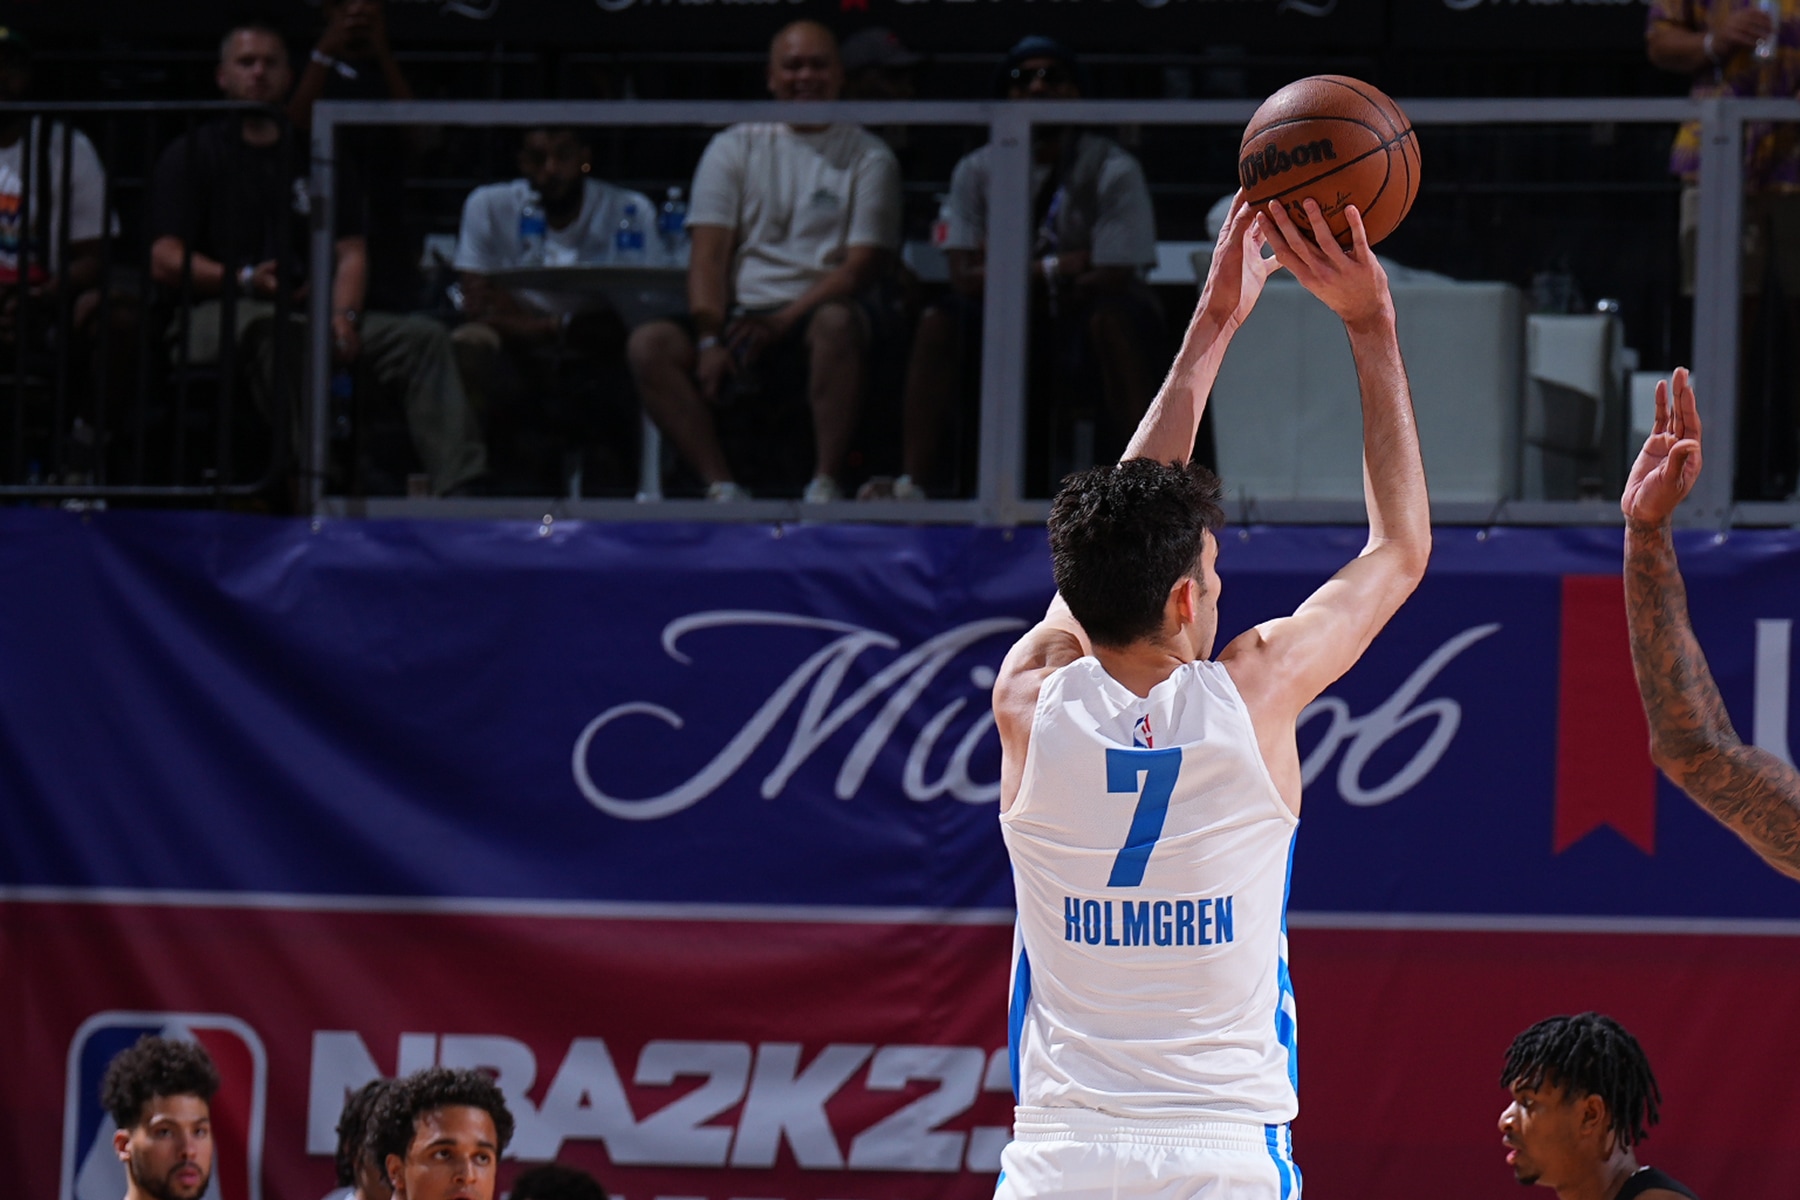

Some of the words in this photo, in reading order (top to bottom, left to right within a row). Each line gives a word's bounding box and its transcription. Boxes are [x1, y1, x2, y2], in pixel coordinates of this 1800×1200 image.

[1240, 138, 1337, 191] Wilson
[1105, 747, 1183, 887] 7
[1064, 895, 1234, 947] HOLMGREN
